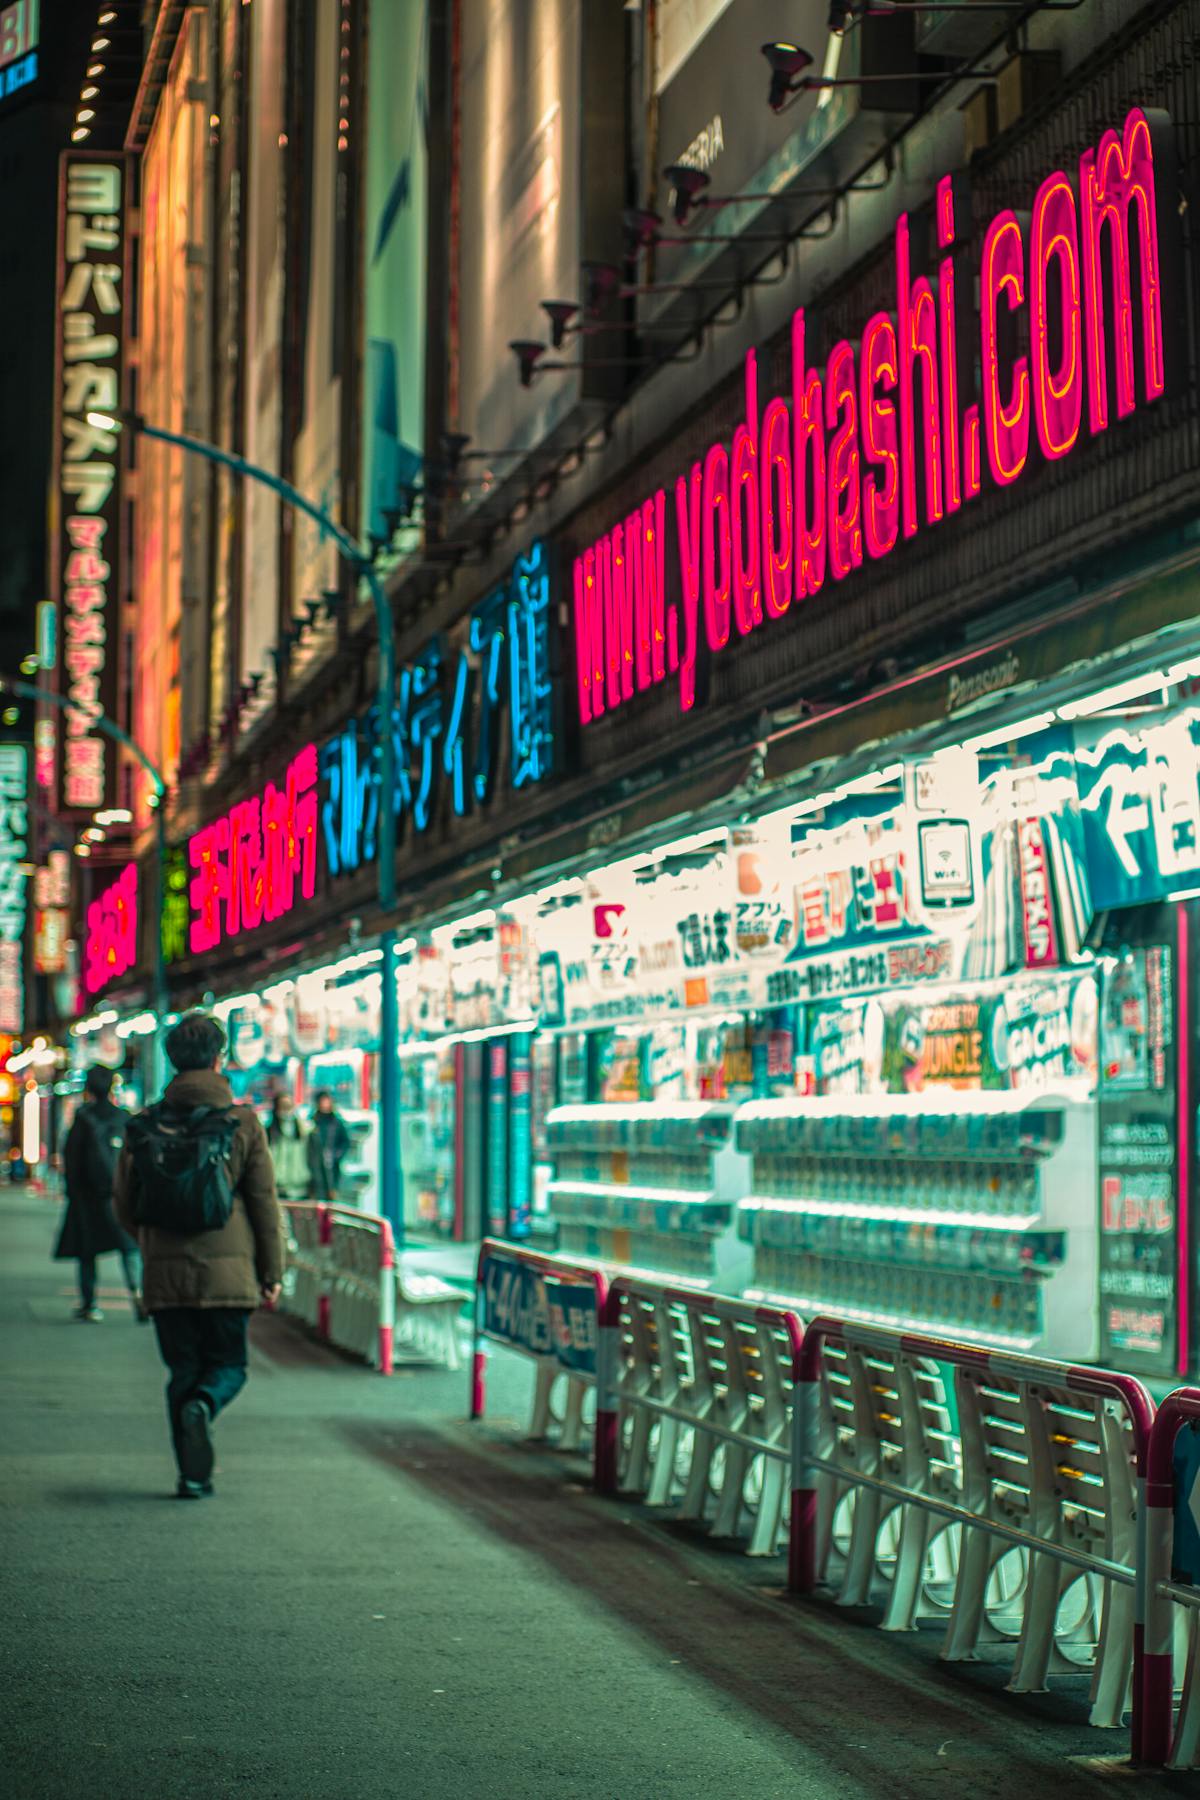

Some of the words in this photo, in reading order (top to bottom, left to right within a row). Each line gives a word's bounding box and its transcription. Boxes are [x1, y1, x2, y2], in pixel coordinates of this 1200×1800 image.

[62, 163, 121, 514] ヨドバシカメラ
[573, 107, 1165, 726] www.yodobashi.com
[945, 651, 1020, 712] Panasonic
[921, 1032, 982, 1075] JUNGLE
